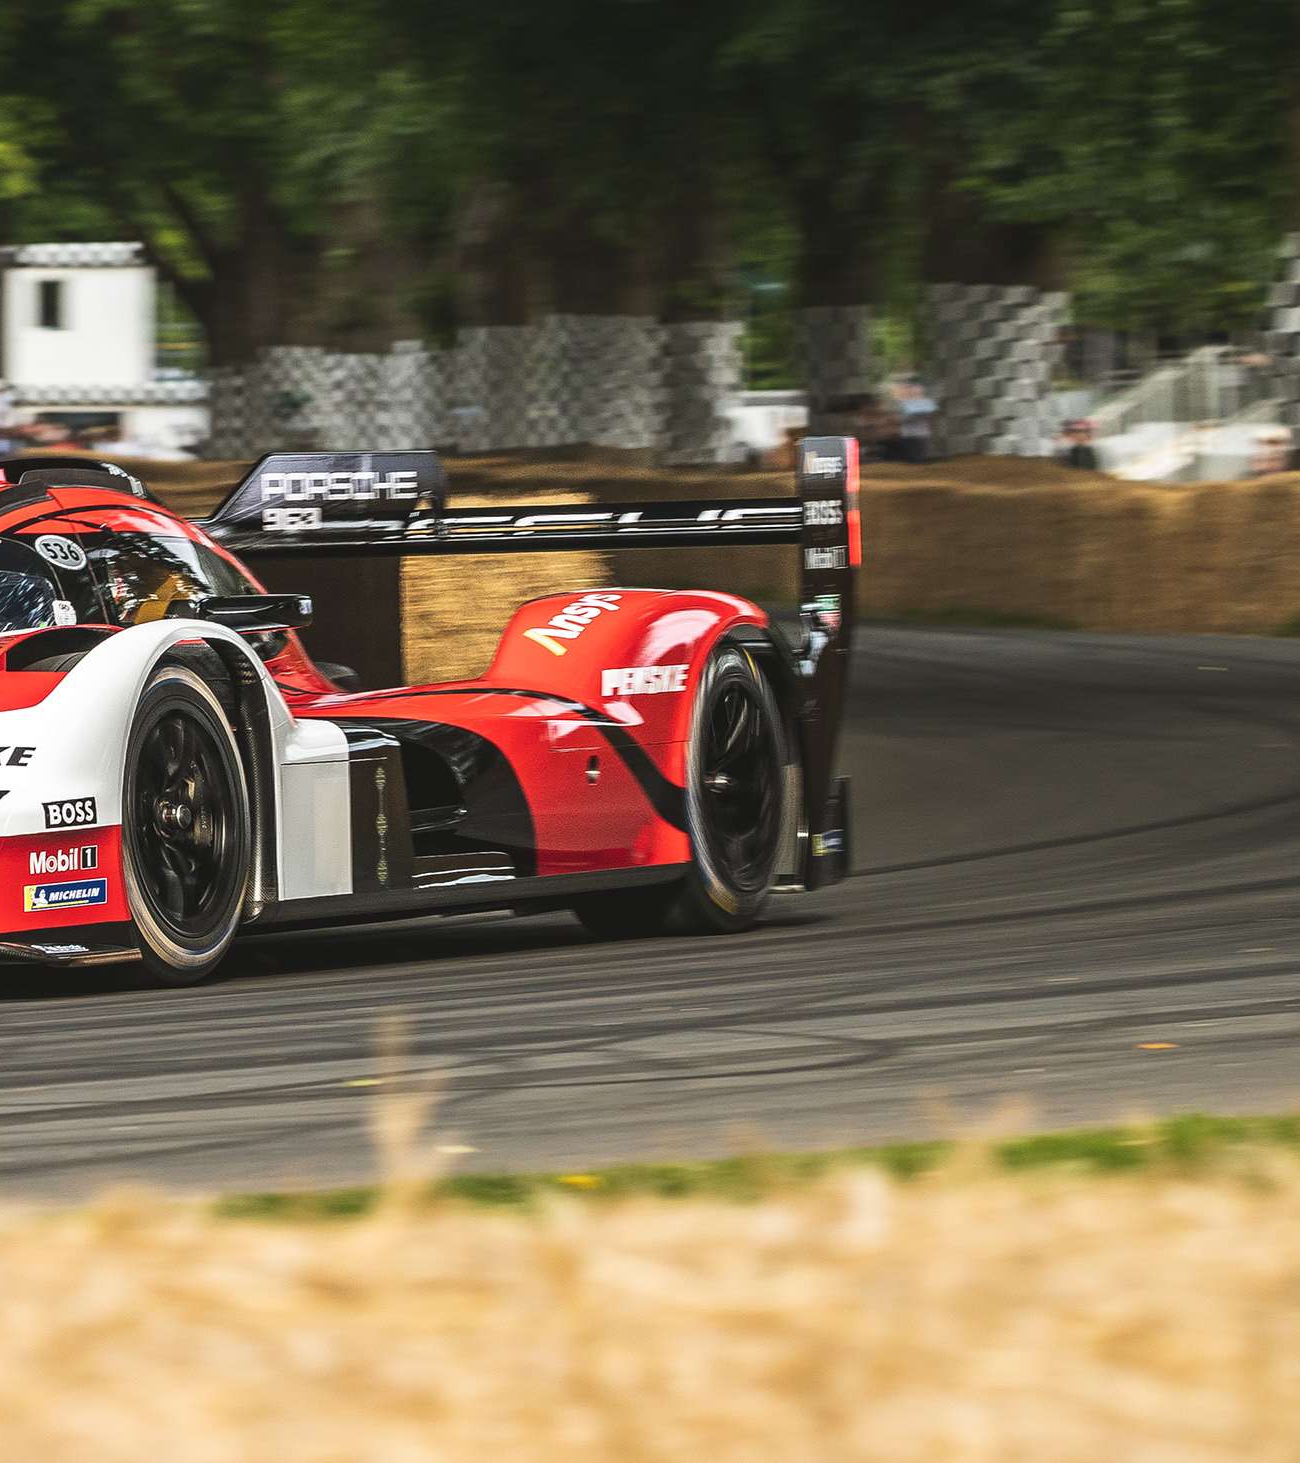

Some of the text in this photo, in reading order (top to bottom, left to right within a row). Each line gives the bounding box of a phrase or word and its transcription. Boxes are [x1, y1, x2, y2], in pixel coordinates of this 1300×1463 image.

[260, 471, 418, 500] PORSCHE
[43, 541, 80, 561] 536
[523, 593, 622, 656] Ansys
[601, 664, 690, 697] PENSKE
[48, 800, 94, 826] BOSS
[29, 848, 79, 875] Mobil
[49, 885, 101, 902] MICHELIN
